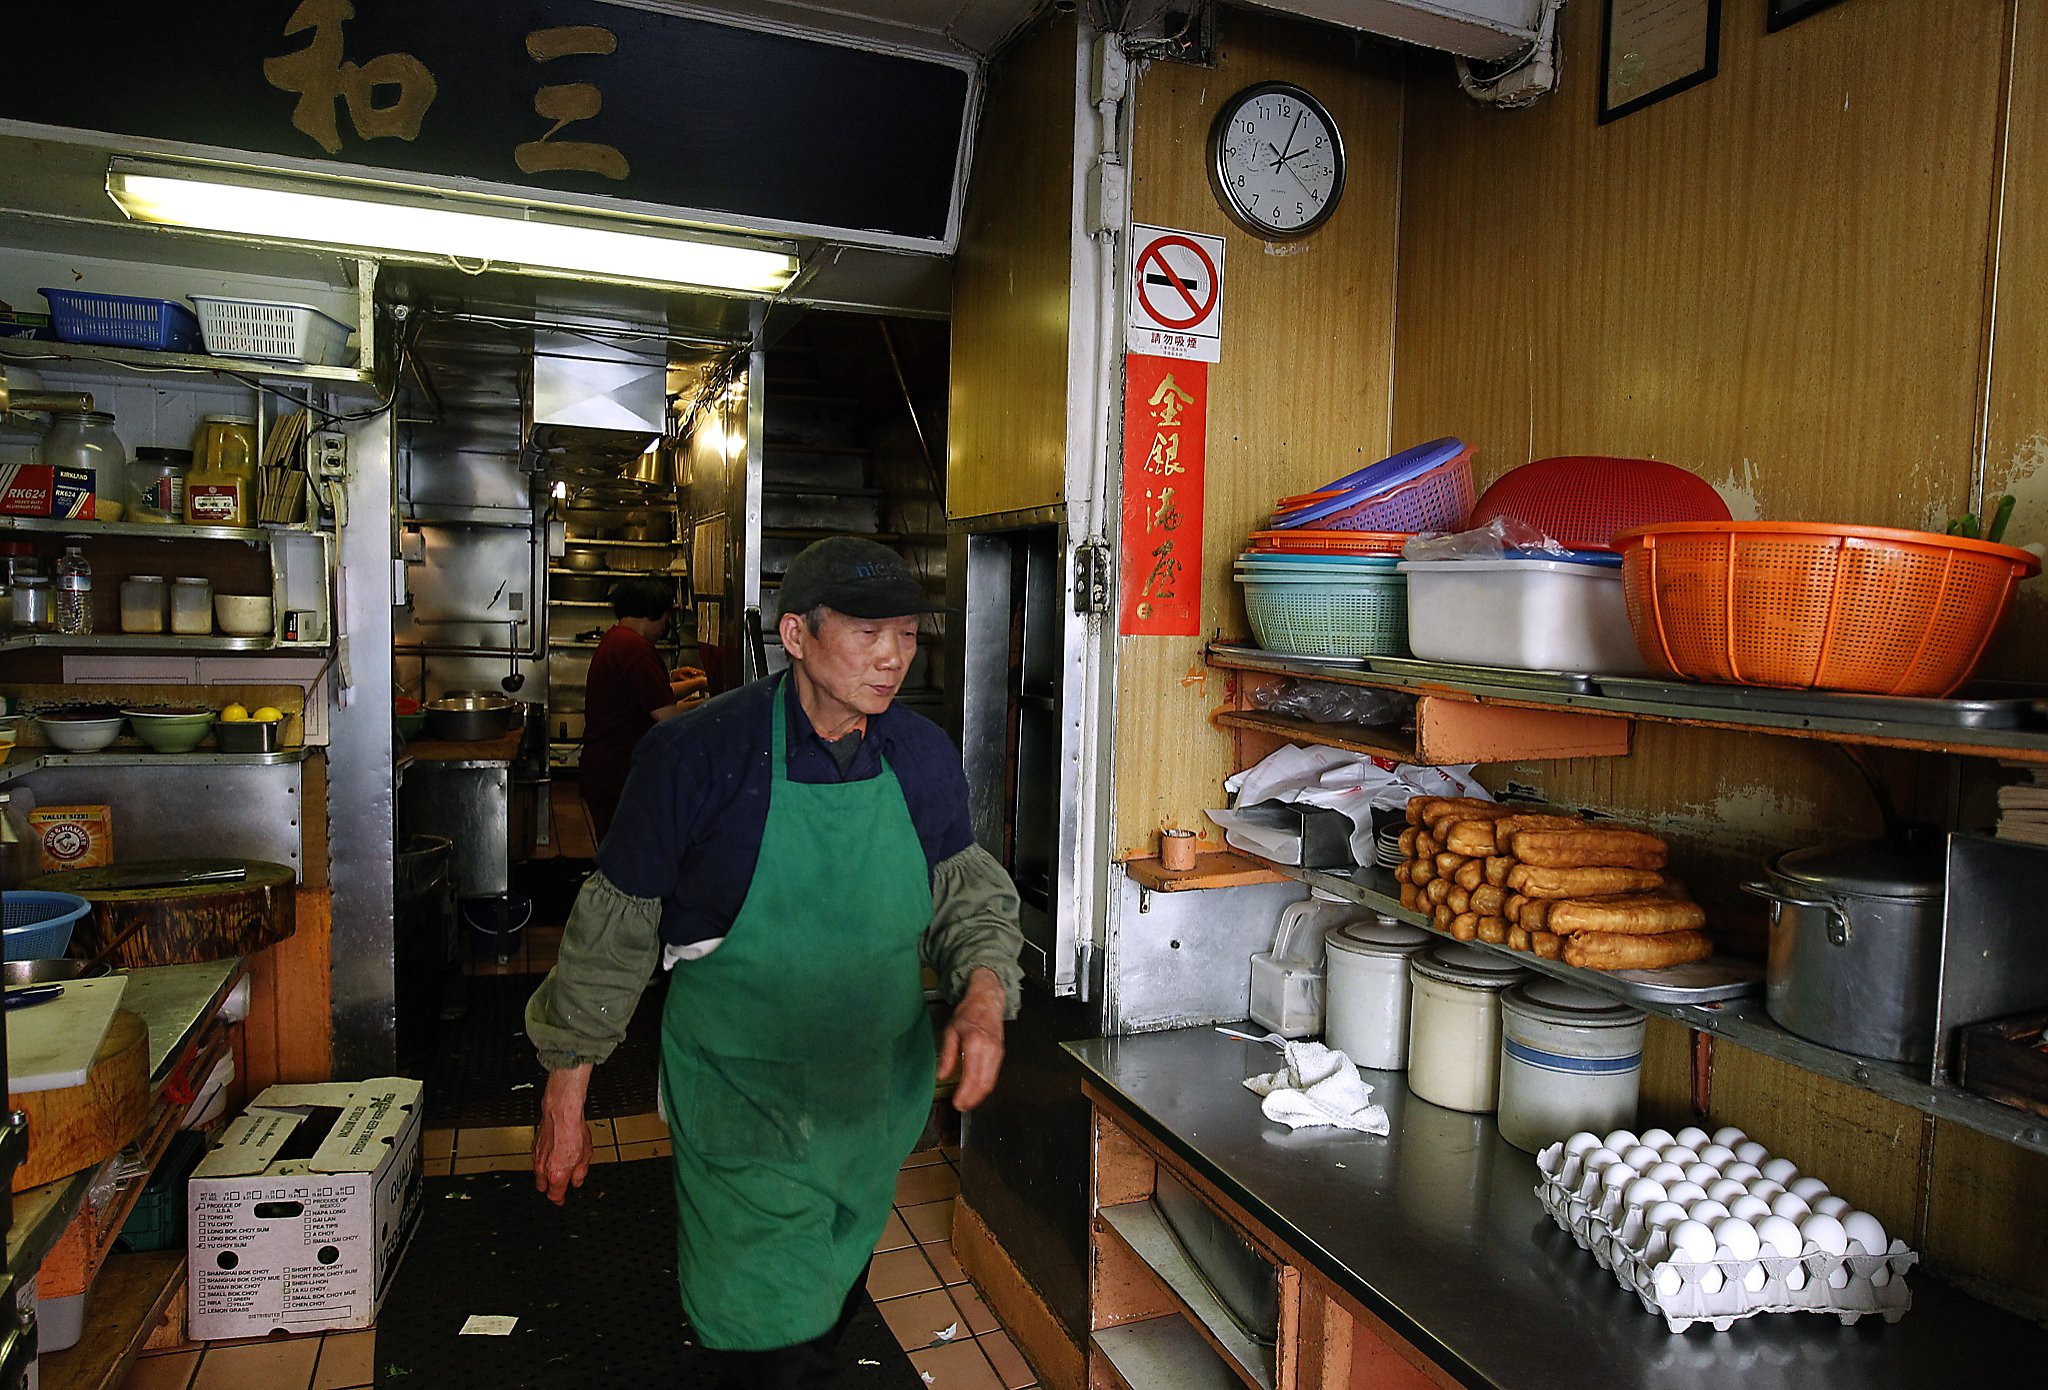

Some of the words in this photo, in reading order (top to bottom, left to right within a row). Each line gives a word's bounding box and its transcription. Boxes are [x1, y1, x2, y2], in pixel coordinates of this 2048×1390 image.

[1258, 106, 1271, 120] 11
[1277, 103, 1291, 118] 12
[1240, 121, 1255, 135] 10
[1302, 117, 1308, 129] 1
[1314, 136, 1323, 149] 2
[1229, 147, 1237, 158] 9
[1322, 166, 1329, 177] 3
[1237, 175, 1246, 187] 8
[1252, 194, 1260, 206] 7
[1311, 188, 1319, 200] 4
[1272, 206, 1281, 218] 6
[1295, 202, 1303, 215] 5
[1151, 332, 1198, 349] 請勿吸煙
[60, 471, 88, 481] KIRKLAND
[8, 489, 47, 499] RK624
[55, 489, 76, 498] RK624
[61, 825, 87, 846] HAMMER
